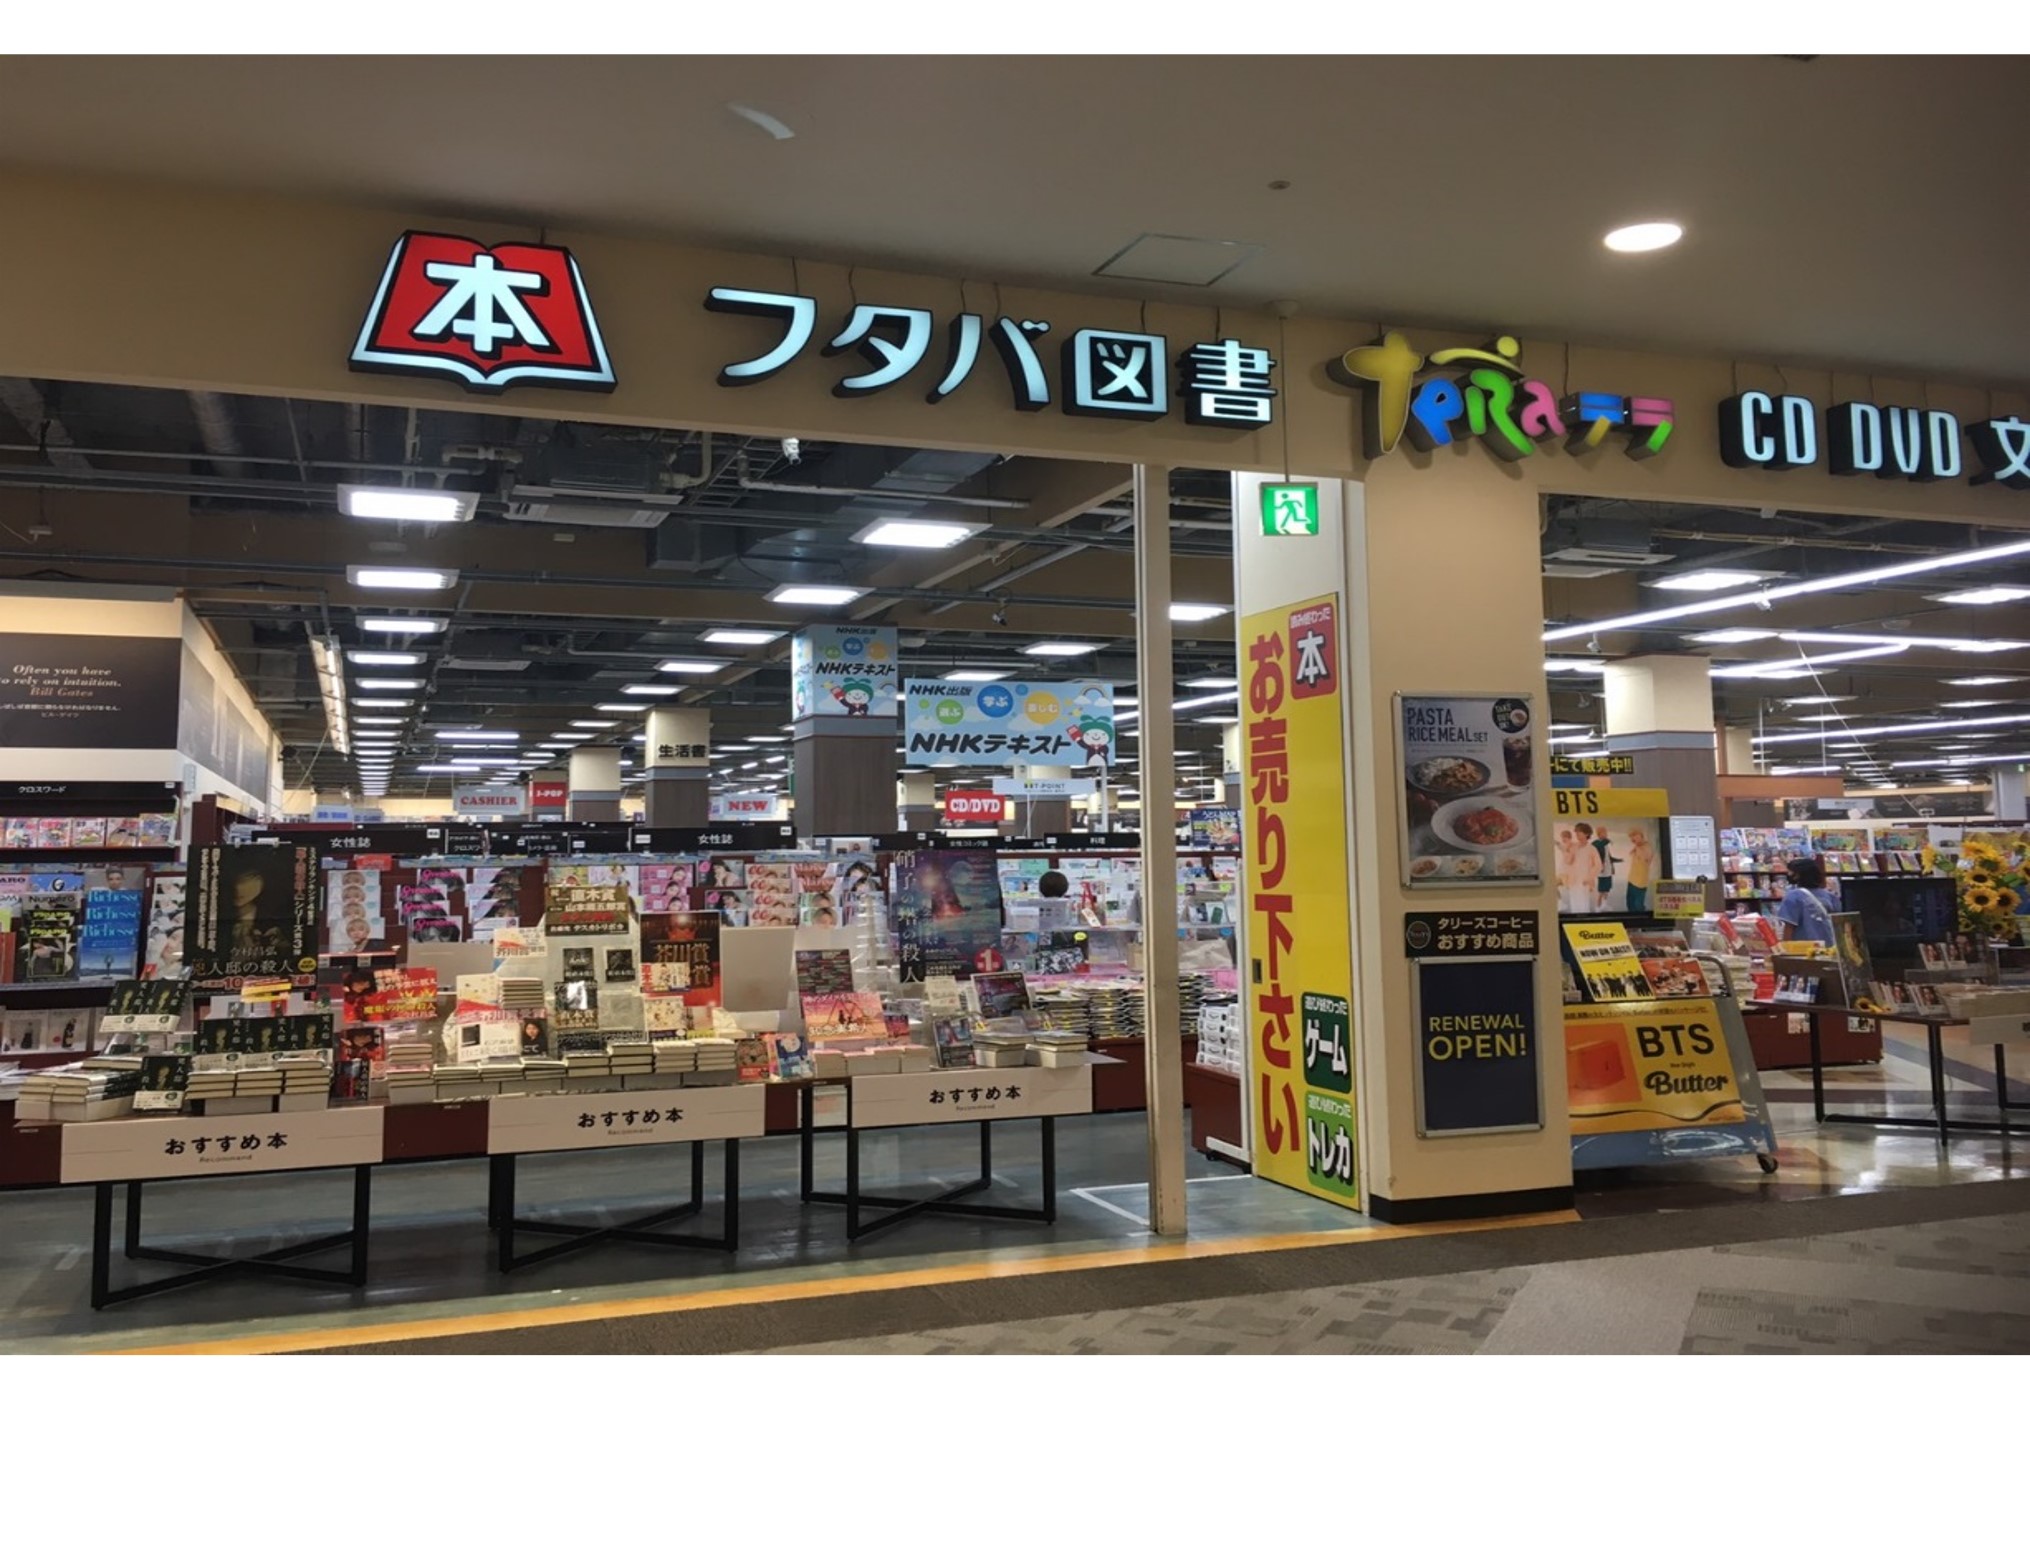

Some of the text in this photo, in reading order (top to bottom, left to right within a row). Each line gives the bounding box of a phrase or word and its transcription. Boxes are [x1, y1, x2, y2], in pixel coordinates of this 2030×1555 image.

[414, 252, 552, 353] 本
[708, 286, 1278, 424] フタバ図書
[1572, 390, 1676, 456] テラ
[1736, 390, 1819, 467] CD
[1847, 401, 1963, 479] DVD
[1296, 630, 1328, 685] 本
[13, 665, 50, 675] Often
[82, 667, 112, 675] have
[815, 662, 896, 676] NHKテキスト
[14, 676, 39, 687] rely
[63, 677, 121, 687] intuition.
[30, 687, 93, 696] Bill Gates
[909, 685, 973, 697] NHK出版
[982, 695, 1009, 707] 学ぶ
[1028, 703, 1058, 713] 楽しむ
[938, 707, 961, 717] 遊ぶ
[1407, 707, 1454, 725] PASTA
[910, 733, 1071, 755] NHKテキスト
[1473, 732, 1488, 741] SET
[658, 744, 706, 758] 生活書
[460, 796, 517, 805] CASHIER
[536, 789, 563, 797] J-POP
[728, 800, 768, 811] NEW
[949, 799, 1000, 813] CD/DVD
[1556, 790, 1599, 814] BTS
[330, 837, 371, 848] 女性誌
[698, 834, 733, 844] 女性誌
[1249, 630, 1301, 1155] お売り下さい
[1437, 917, 1534, 930] タリーズコーヒー
[1437, 933, 1535, 950] おすすめ商品
[1579, 930, 1615, 940] Butter
[1428, 1014, 1525, 1032] RENEWAL
[1305, 1018, 1349, 1075] ゲーム
[1428, 1034, 1527, 1061] OPEN!
[1635, 1023, 1715, 1058] BTS
[1643, 1070, 1729, 1096] Butter
[928, 1084, 1022, 1104] おすすめ本
[577, 1107, 684, 1128] おすすめ本
[164, 1132, 288, 1155] おすすめ本
[1308, 1117, 1351, 1180] トレカ
